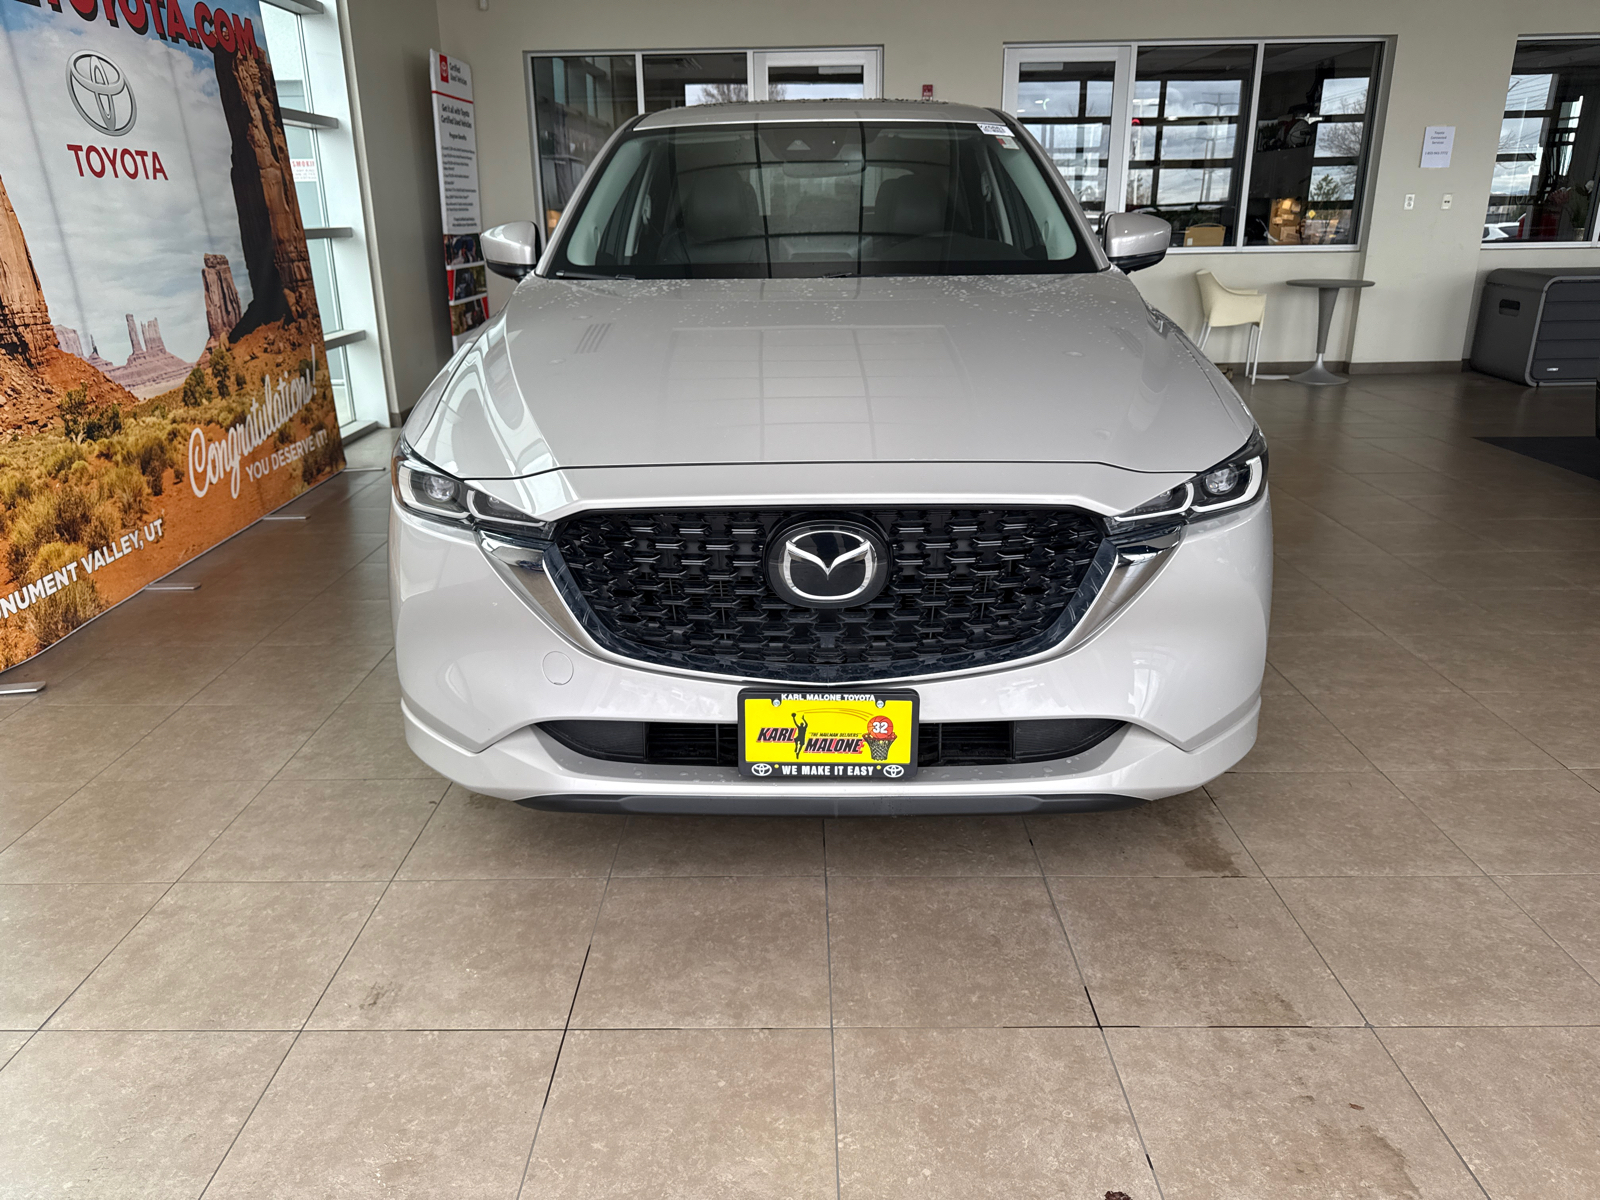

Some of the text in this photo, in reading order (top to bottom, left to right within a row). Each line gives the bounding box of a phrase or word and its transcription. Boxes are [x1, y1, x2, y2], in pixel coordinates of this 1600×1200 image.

[66, 143, 169, 181] TOYOTA
[188, 344, 318, 499] Congratulations!
[246, 428, 329, 482] YOU DESERVE IT!
[0, 518, 164, 619] NUMENT VALLEY, UT
[781, 693, 875, 701] KARL MALONE TOYOTA
[756, 727, 798, 743] KARL
[872, 721, 888, 734] 32
[803, 738, 865, 754] MALONE
[781, 765, 874, 776] WE MAKE IT EASY
